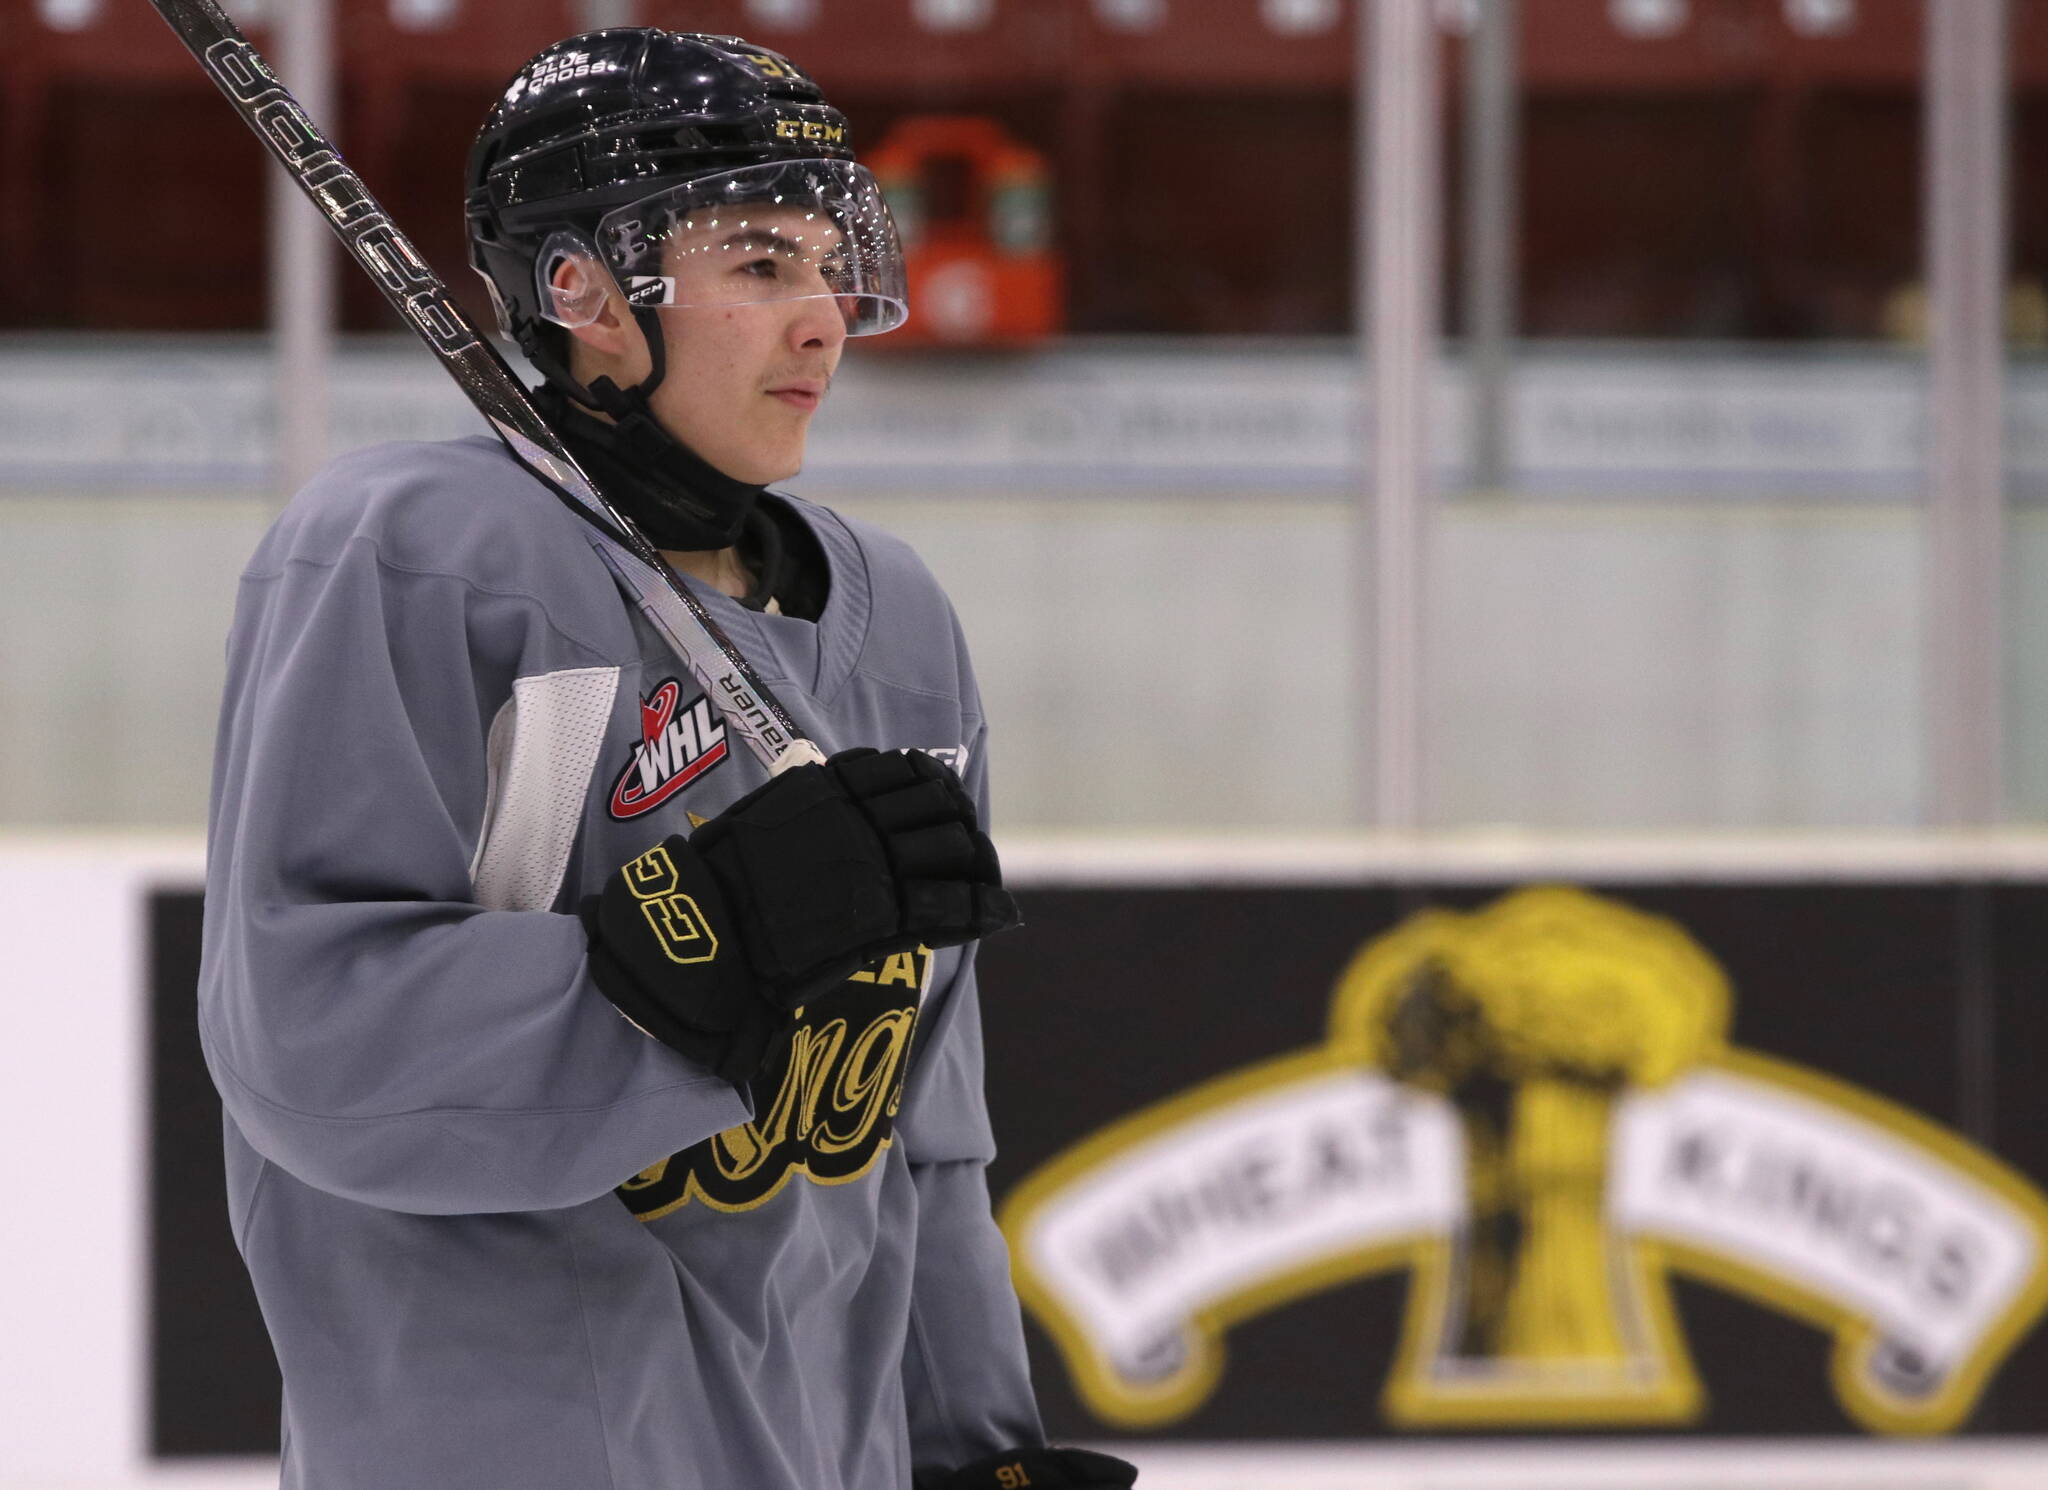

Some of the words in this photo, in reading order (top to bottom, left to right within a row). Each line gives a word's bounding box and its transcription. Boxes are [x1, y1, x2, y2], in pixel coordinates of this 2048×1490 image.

[527, 60, 607, 94] CROSS
[531, 52, 591, 79] BLUE
[776, 120, 844, 143] CCM
[628, 281, 664, 302] CCM
[634, 697, 726, 795] WHL
[1668, 1118, 1990, 1310] KINGS
[995, 1462, 1032, 1490] 91
